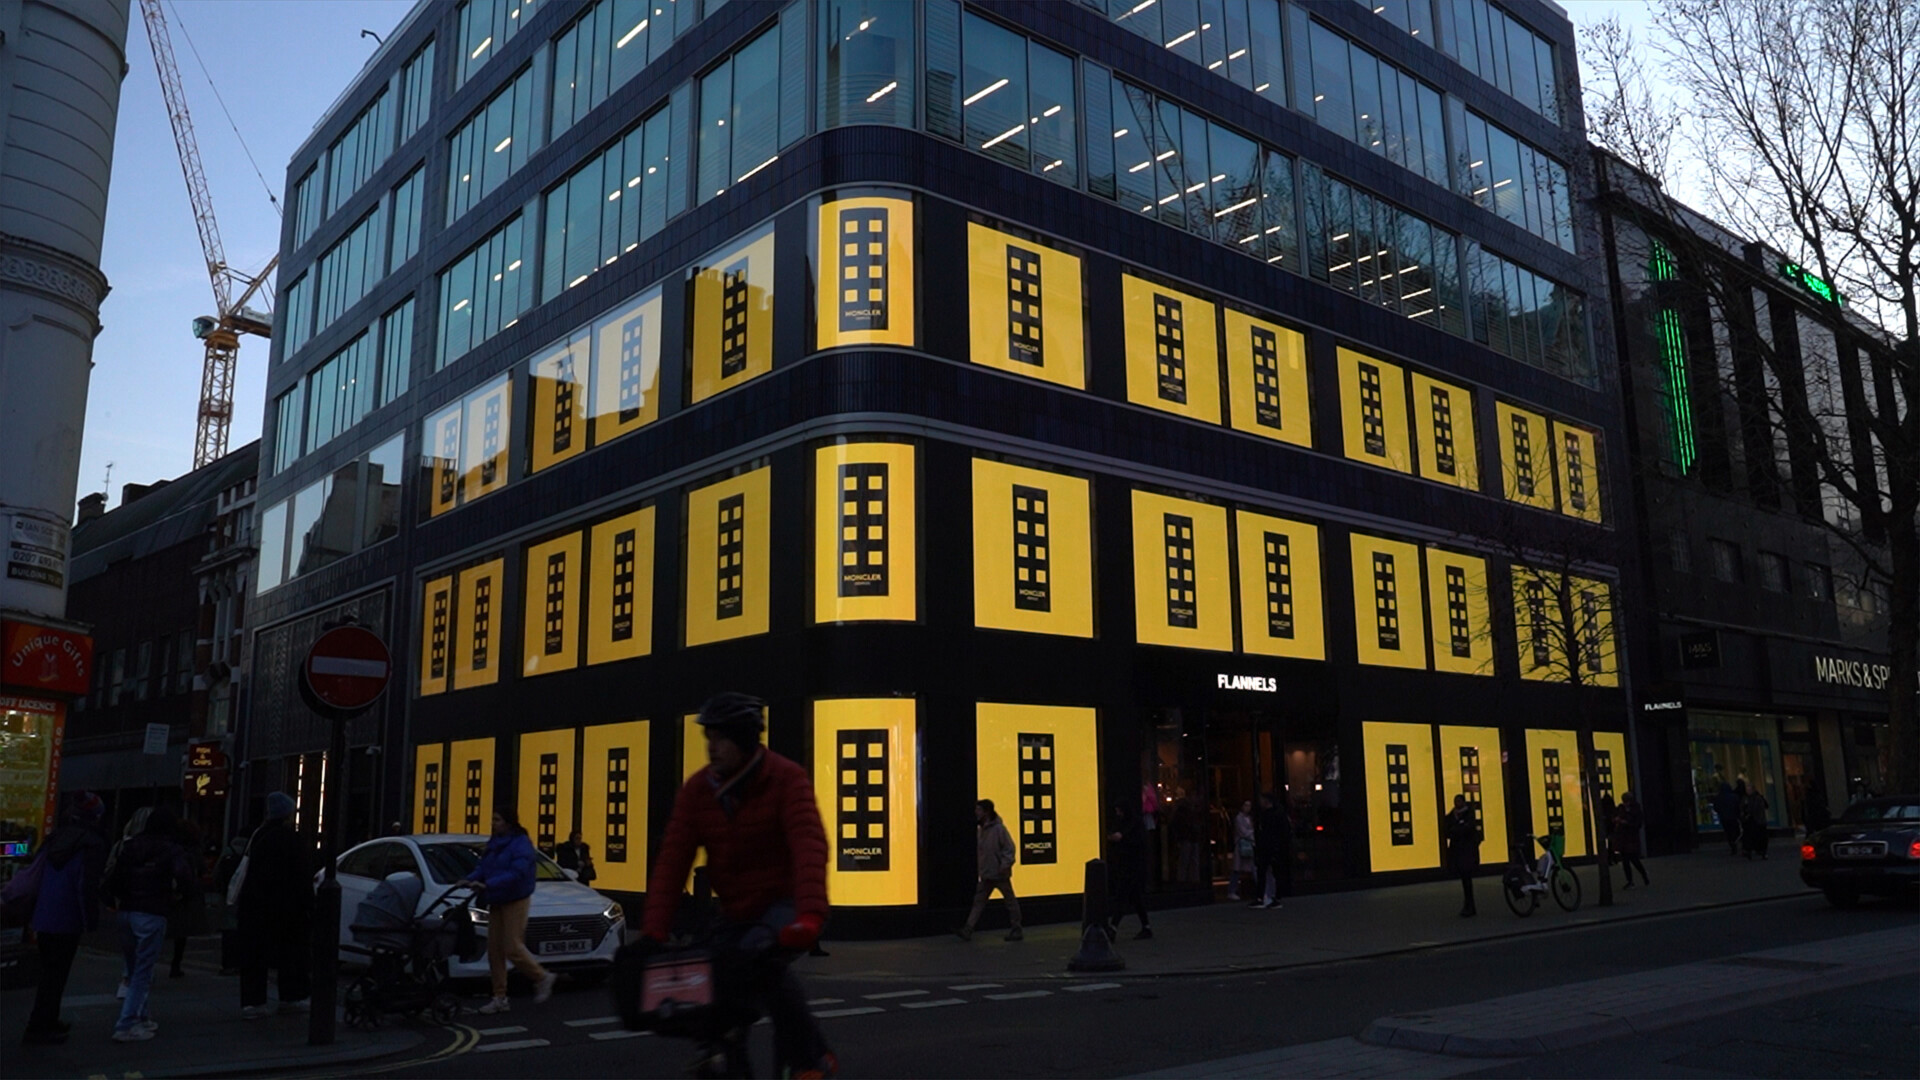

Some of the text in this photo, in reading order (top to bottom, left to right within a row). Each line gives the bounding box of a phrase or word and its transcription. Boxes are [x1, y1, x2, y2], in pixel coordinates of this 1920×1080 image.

[845, 308, 882, 317] MONCLER
[843, 573, 882, 581] MONCLER
[12, 635, 85, 677] Unique Gifts
[1217, 673, 1278, 693] FLANNELS
[18, 699, 56, 712] LICENCE
[843, 847, 882, 856] MONCLER
